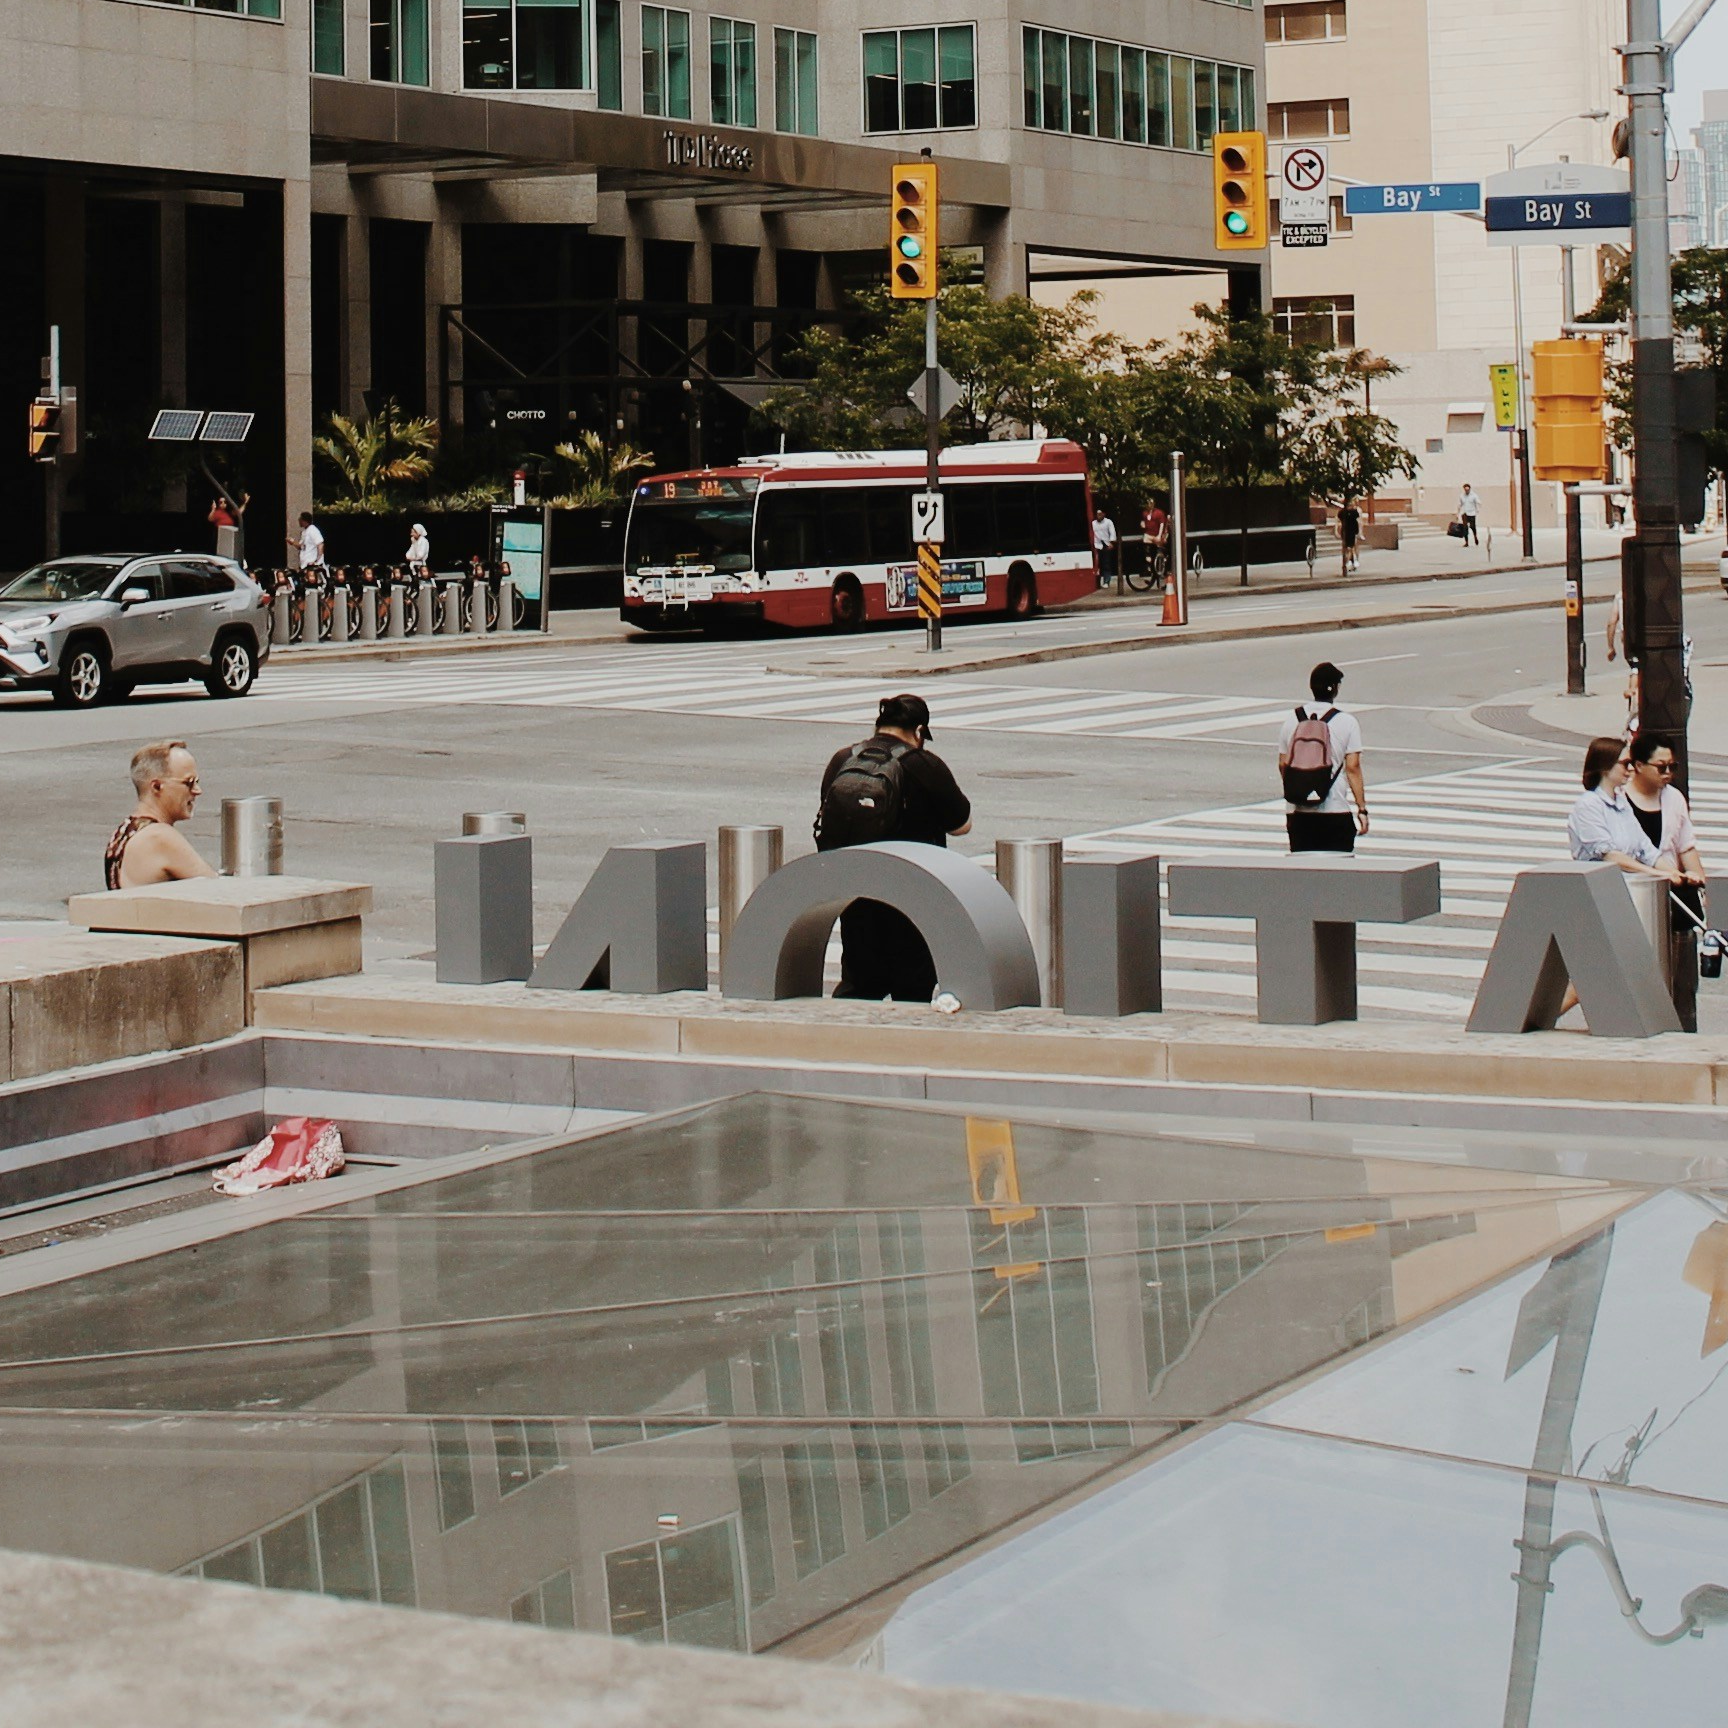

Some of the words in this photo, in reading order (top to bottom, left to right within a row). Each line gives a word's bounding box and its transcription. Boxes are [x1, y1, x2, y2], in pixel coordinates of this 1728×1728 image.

[1382, 187, 1422, 212] Bay
[1428, 185, 1441, 197] St
[1524, 199, 1564, 227] Bay
[1574, 200, 1592, 220] St
[506, 410, 546, 420] CHOTTO
[664, 482, 675, 499] 19
